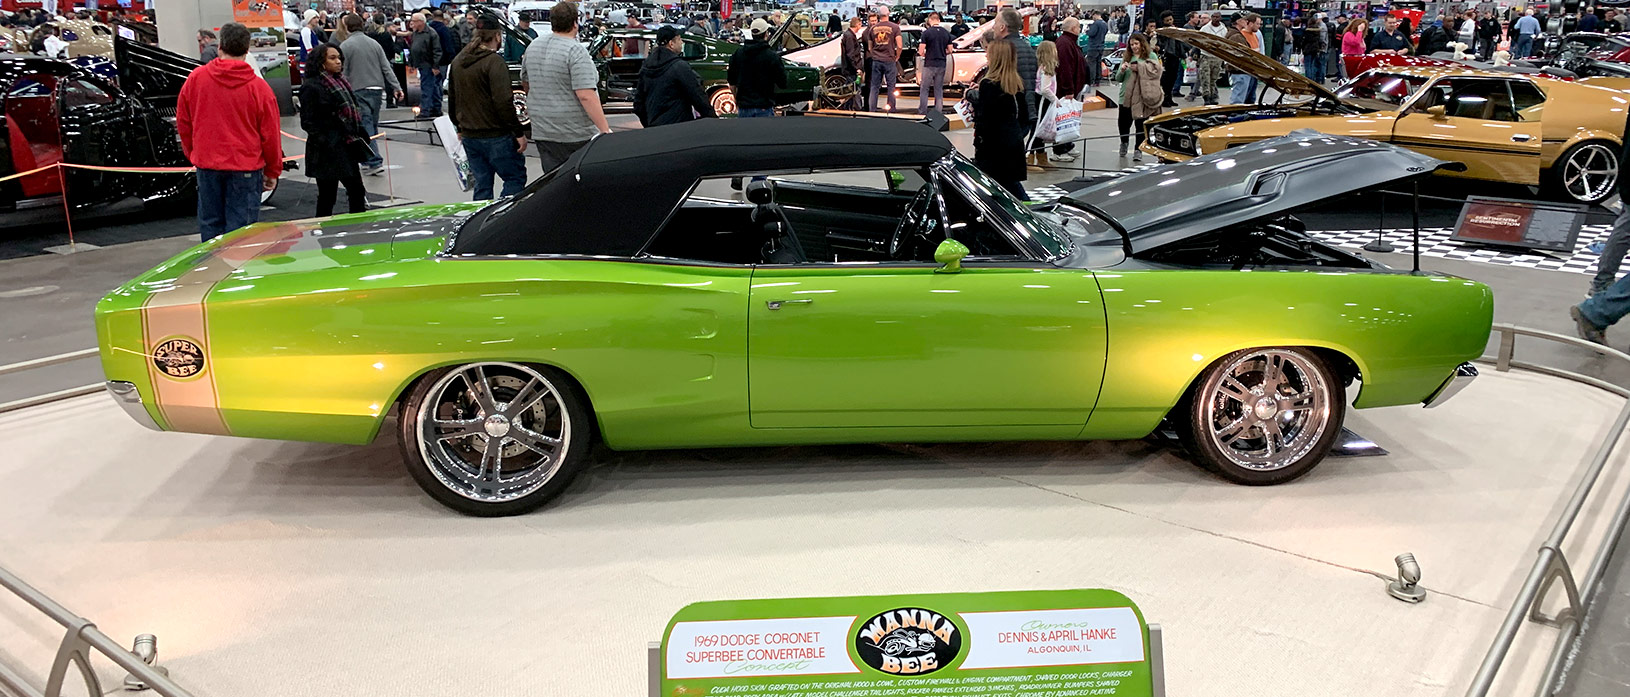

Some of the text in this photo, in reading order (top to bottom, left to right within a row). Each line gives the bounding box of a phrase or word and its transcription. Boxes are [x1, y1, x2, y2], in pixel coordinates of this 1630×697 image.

[1470, 218, 1521, 227] RESURRECTION
[156, 340, 198, 358] SUPER
[165, 365, 197, 376] BEE
[860, 608, 956, 646] WANNA
[1021, 620, 1088, 632] Owners
[694, 632, 820, 647] 1969 DODGE CORONET
[998, 628, 1117, 643] DENNIS & APRIL HANKE
[685, 647, 826, 664] SUPERBEE CONVERTABLE
[1027, 644, 1092, 654] ALGONQUIN, IL
[723, 659, 813, 675] Concept
[880, 652, 939, 674] BEE
[731, 684, 749, 693] HOOD
[750, 684, 768, 692] SKIN
[768, 682, 799, 692] GRAFTED
[800, 682, 812, 690] ON
[811, 682, 825, 690] THE
[824, 681, 852, 689] ORIGINAL
[897, 678, 926, 686] CUSTOM
[925, 677, 956, 685] FIREWALL
[962, 676, 986, 684] ENGINE
[1034, 673, 1060, 681] SHAVED
[1078, 671, 1101, 681] LOCKS,
[1101, 669, 1133, 678] CHARGER
[829, 689, 870, 697] CHALLENGER
[906, 687, 931, 695] ROCKER
[931, 686, 954, 694] PANELS
[954, 685, 987, 693] EXTENDED
[1019, 682, 1063, 690] ROADRUNNER
[1063, 681, 1095, 689] BUMPERS
[1095, 679, 1121, 688] SHAVED
[1055, 688, 1090, 697] ADVANCED
[1089, 687, 1117, 696] PLATING
